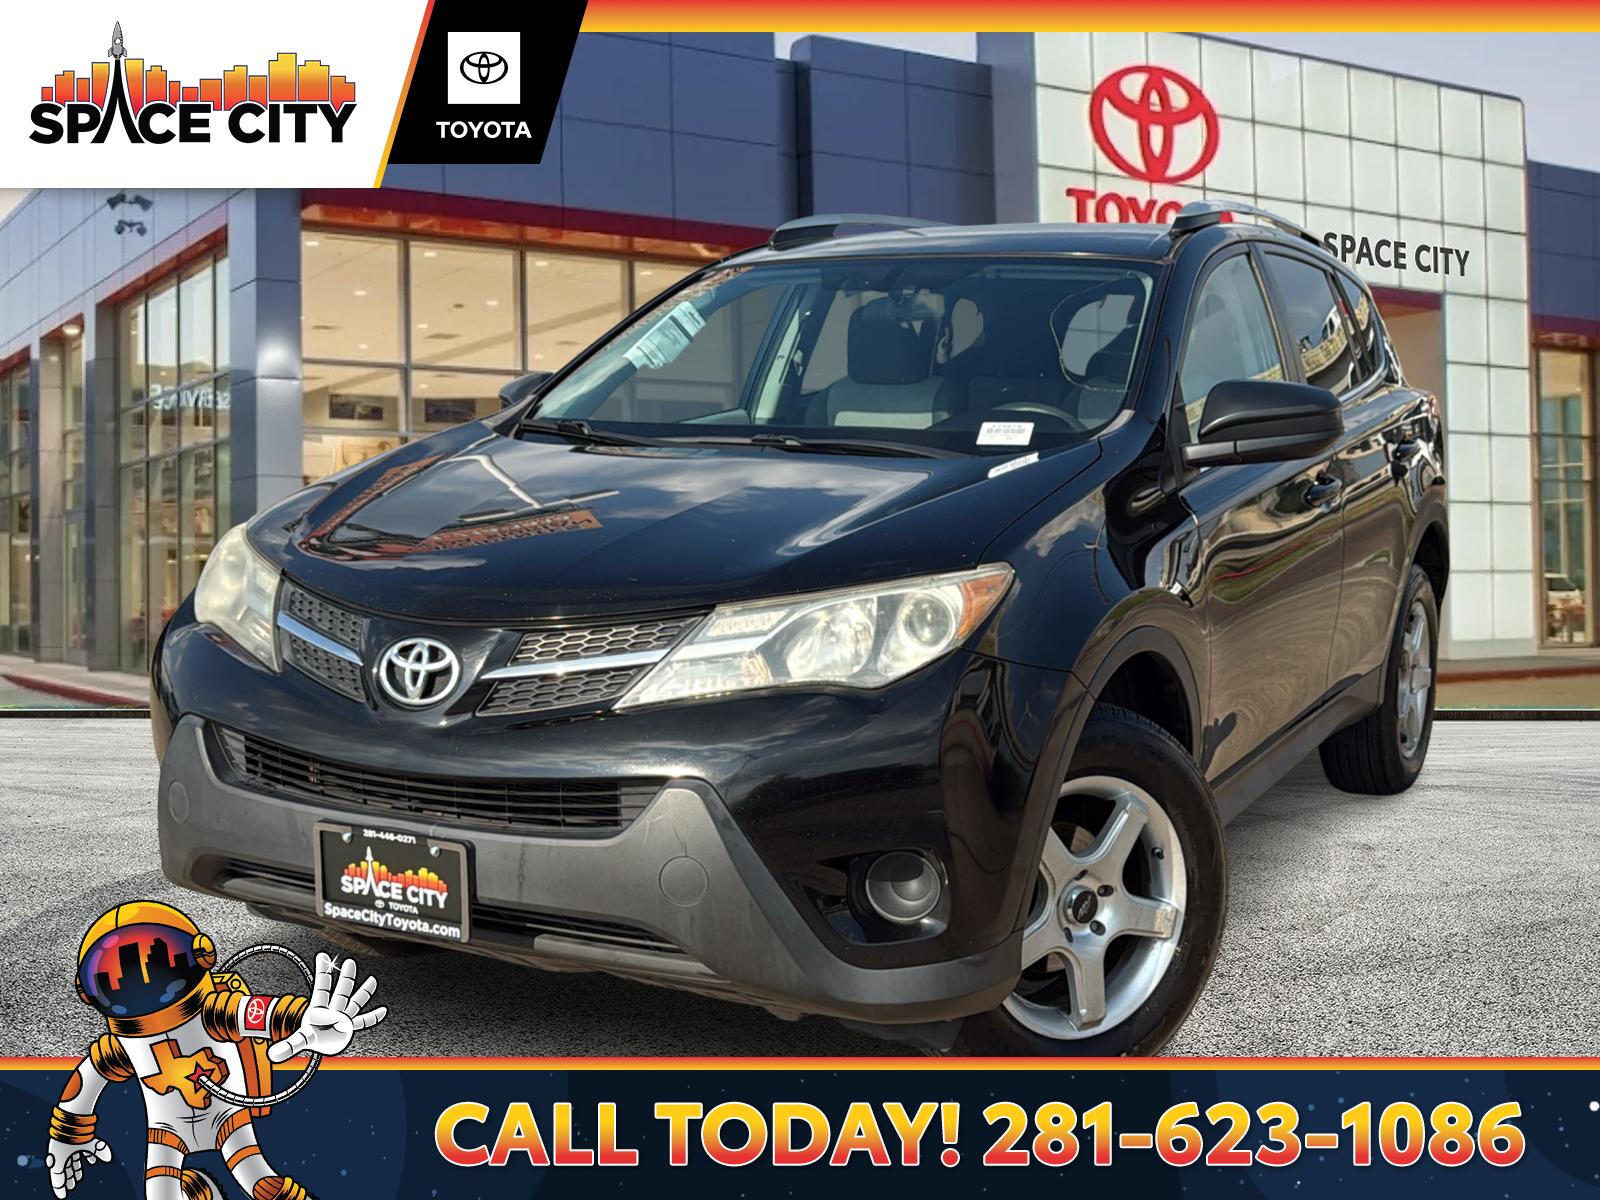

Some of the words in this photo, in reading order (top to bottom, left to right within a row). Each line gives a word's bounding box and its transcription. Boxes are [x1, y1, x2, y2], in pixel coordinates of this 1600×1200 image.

[1066, 188, 1184, 224] TOYO
[1323, 232, 1407, 270] SPACE
[1414, 244, 1469, 276] CITY
[363, 829, 416, 844] 281-446-0271
[388, 901, 419, 915] TOYOTA
[406, 885, 448, 909] CITY
[324, 902, 461, 938] SpaceCityToyota.com
